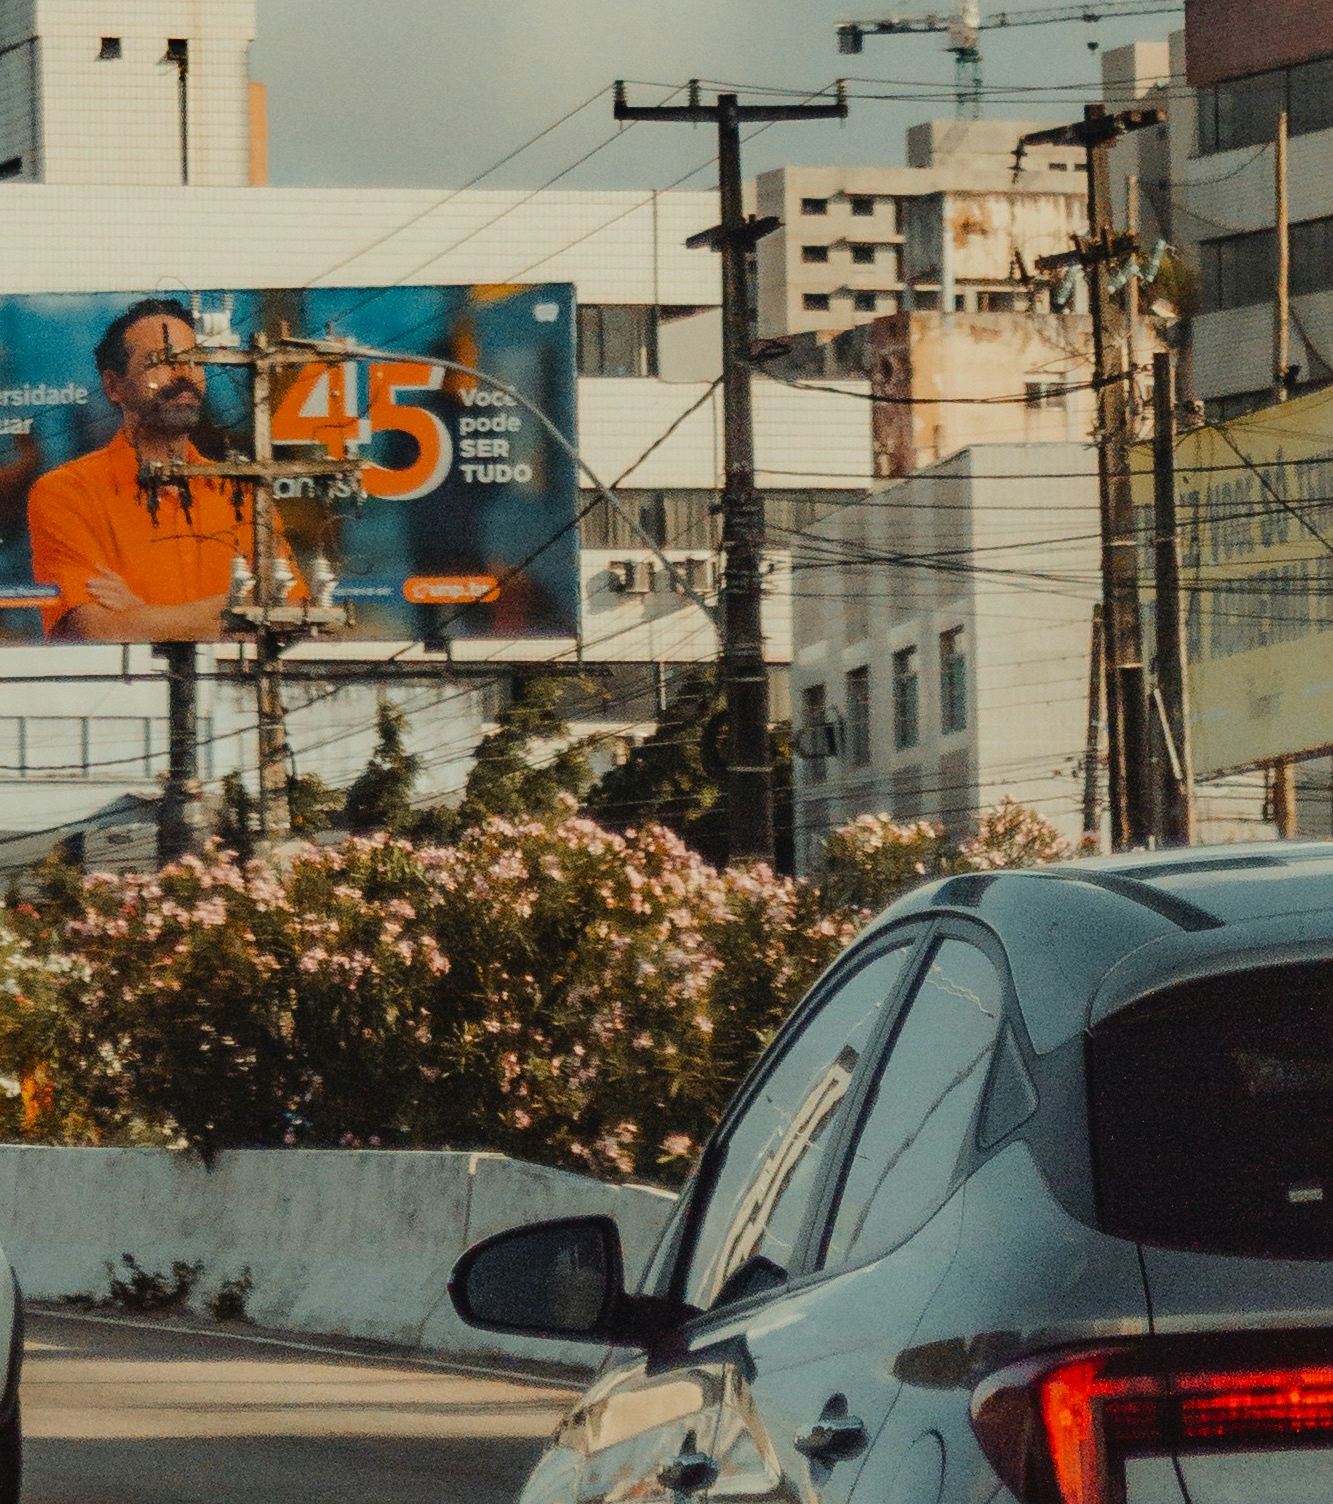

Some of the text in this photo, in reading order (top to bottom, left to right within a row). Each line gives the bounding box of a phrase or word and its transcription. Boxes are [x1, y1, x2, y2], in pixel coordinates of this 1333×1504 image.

[271, 340, 453, 500] 45
[459, 414, 523, 435] pode
[459, 438, 510, 458] SER
[460, 464, 533, 484] TUDO
[272, 476, 354, 499] ans
